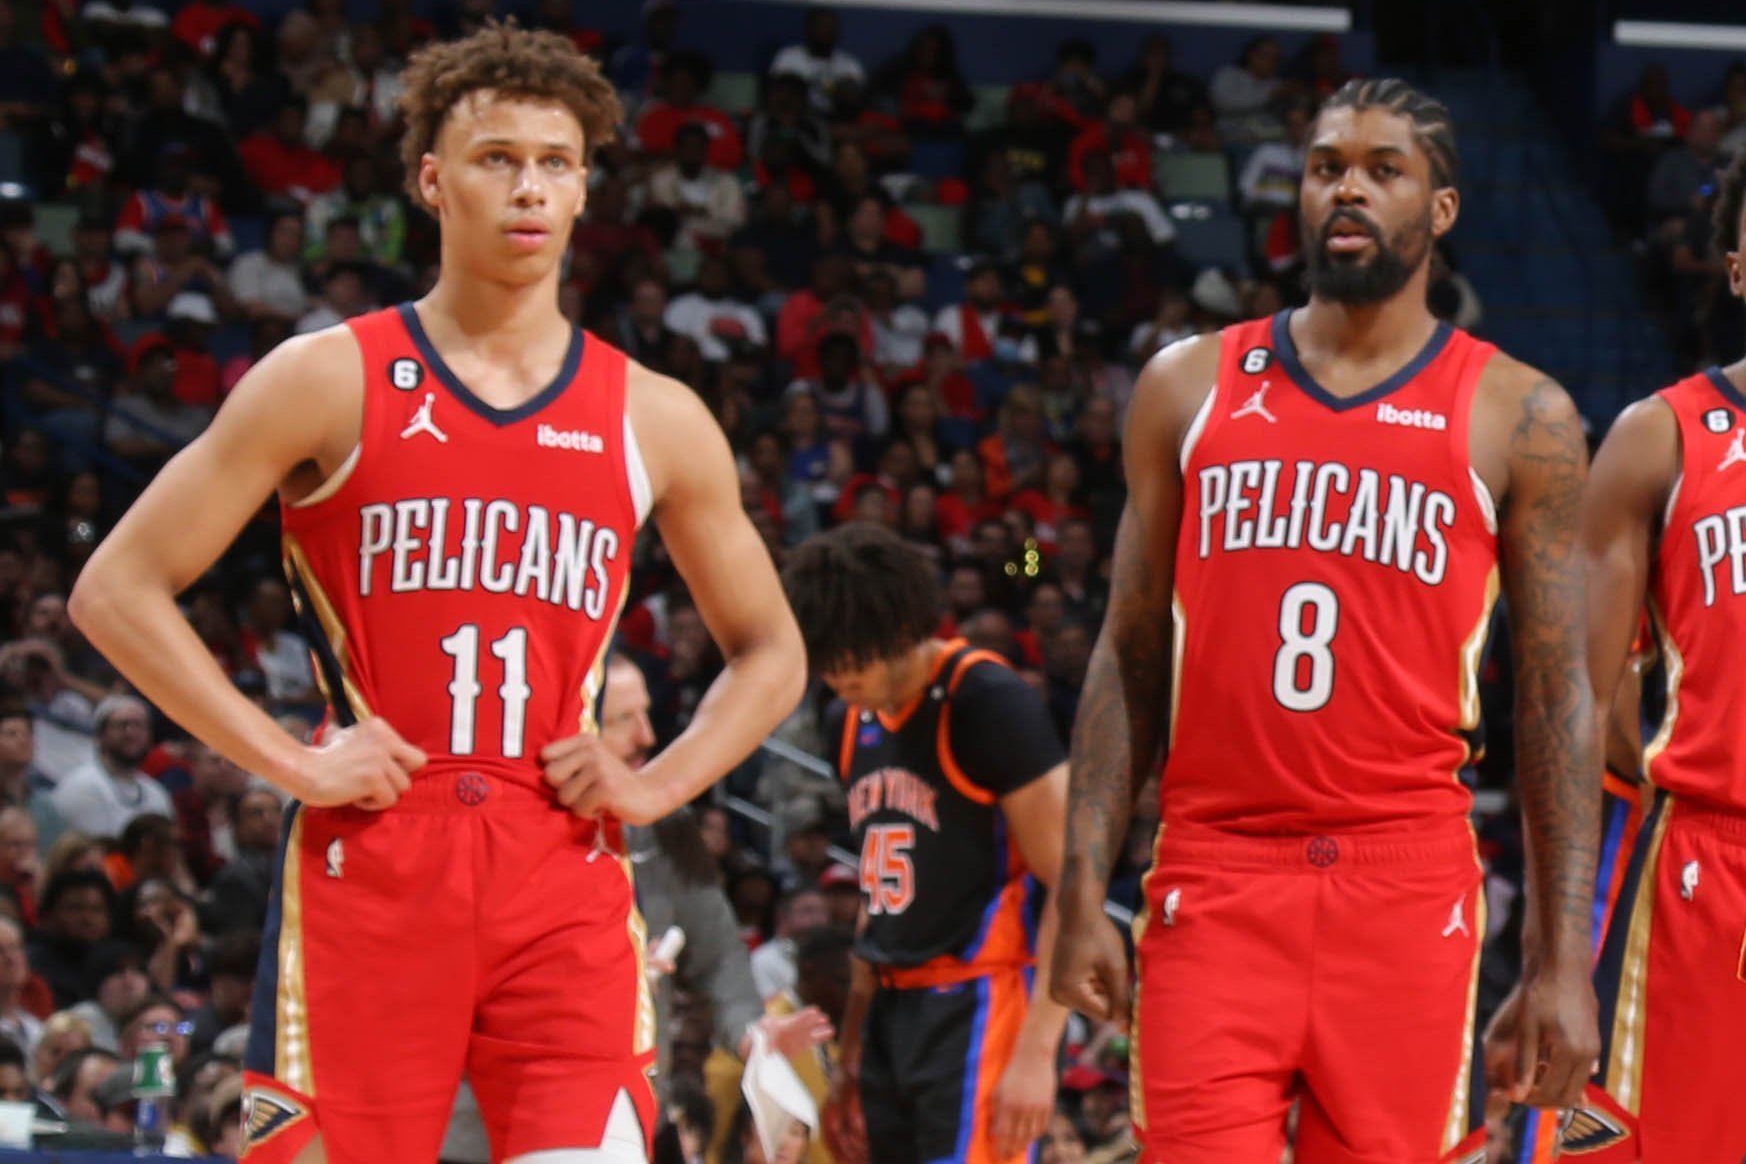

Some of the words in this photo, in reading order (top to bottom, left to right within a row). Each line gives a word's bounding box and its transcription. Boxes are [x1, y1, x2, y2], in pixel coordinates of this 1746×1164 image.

[394, 358, 418, 389] 6
[1244, 348, 1269, 374] 6
[537, 424, 604, 454] ibotta
[1376, 403, 1447, 431] ibotta
[359, 496, 619, 621] PELICANS
[1199, 459, 1457, 587] PELICANS
[441, 622, 532, 759] 11
[1272, 581, 1339, 714] 8
[859, 821, 915, 916] 45
